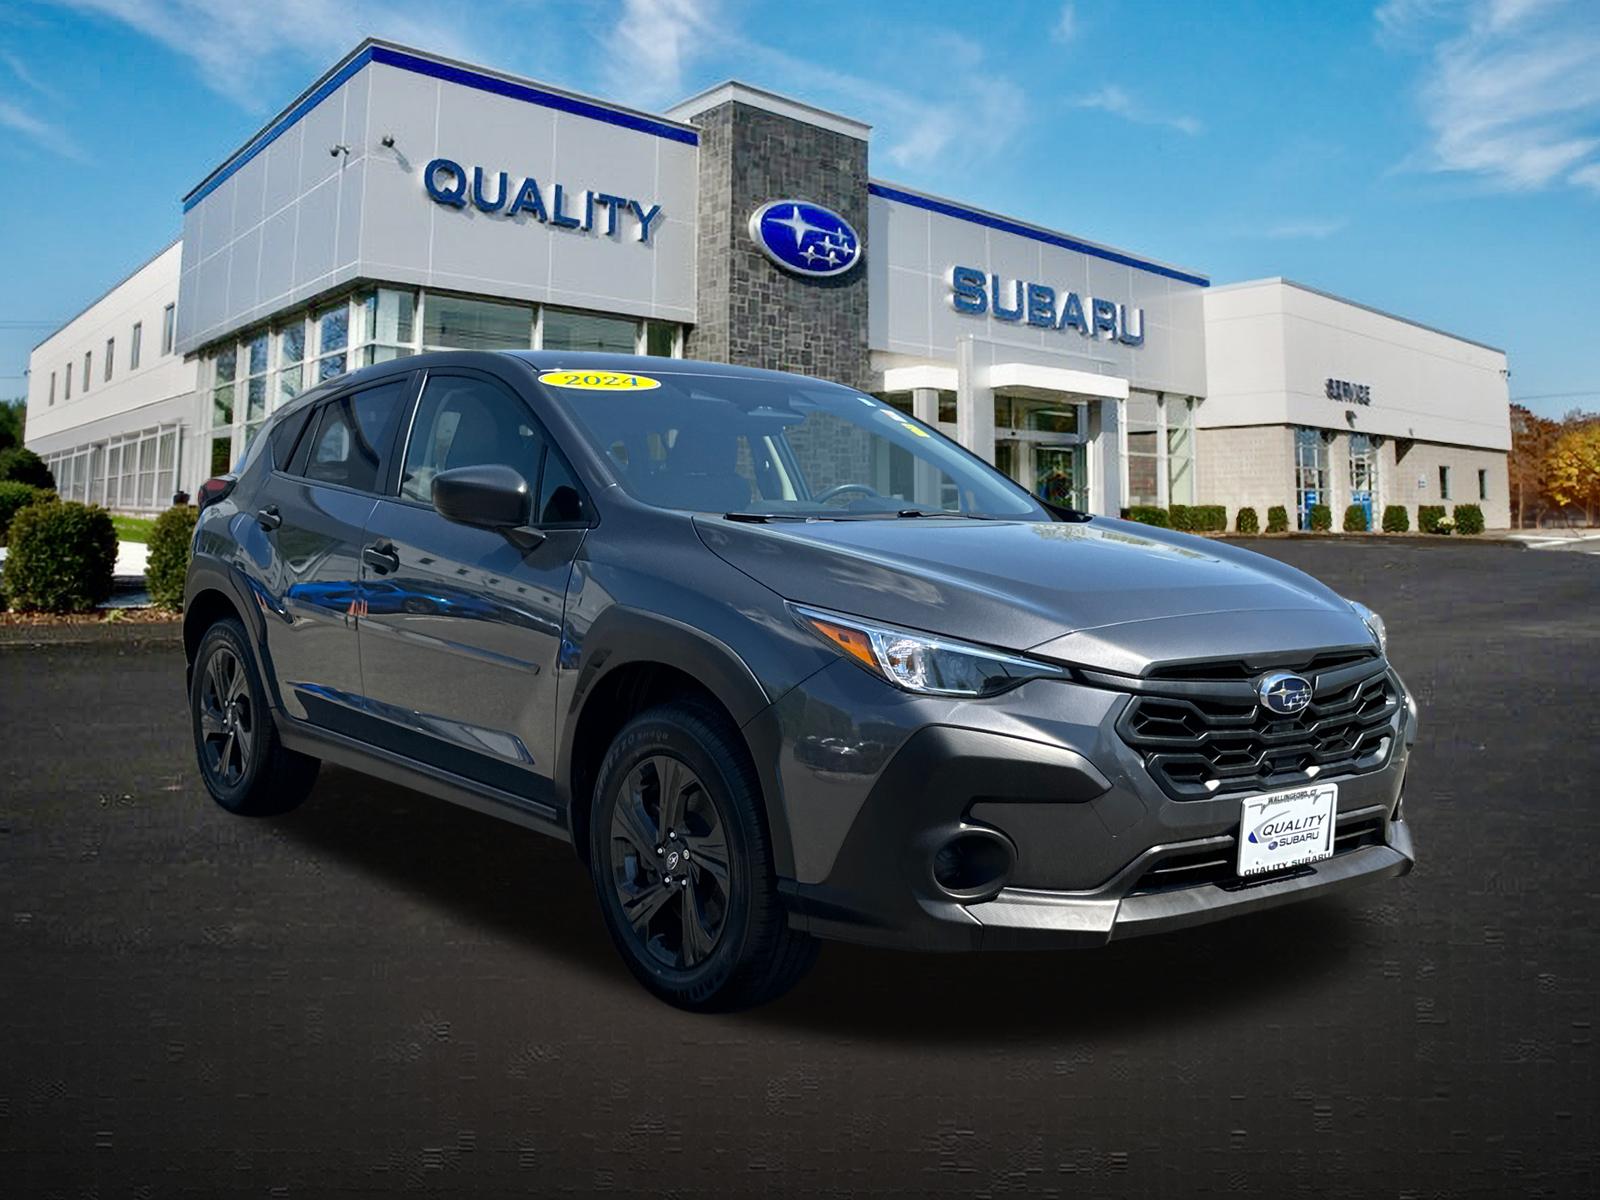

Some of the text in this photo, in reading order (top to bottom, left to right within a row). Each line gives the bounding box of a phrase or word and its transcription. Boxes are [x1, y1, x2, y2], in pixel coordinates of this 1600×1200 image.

[423, 158, 662, 243] QUALITY
[950, 265, 1145, 347] SUBARU
[564, 374, 640, 387] 2024
[1263, 813, 1327, 836] QUALITY
[1279, 831, 1320, 847] SUBARU
[1244, 851, 1331, 876] QUALITY SUBARU
